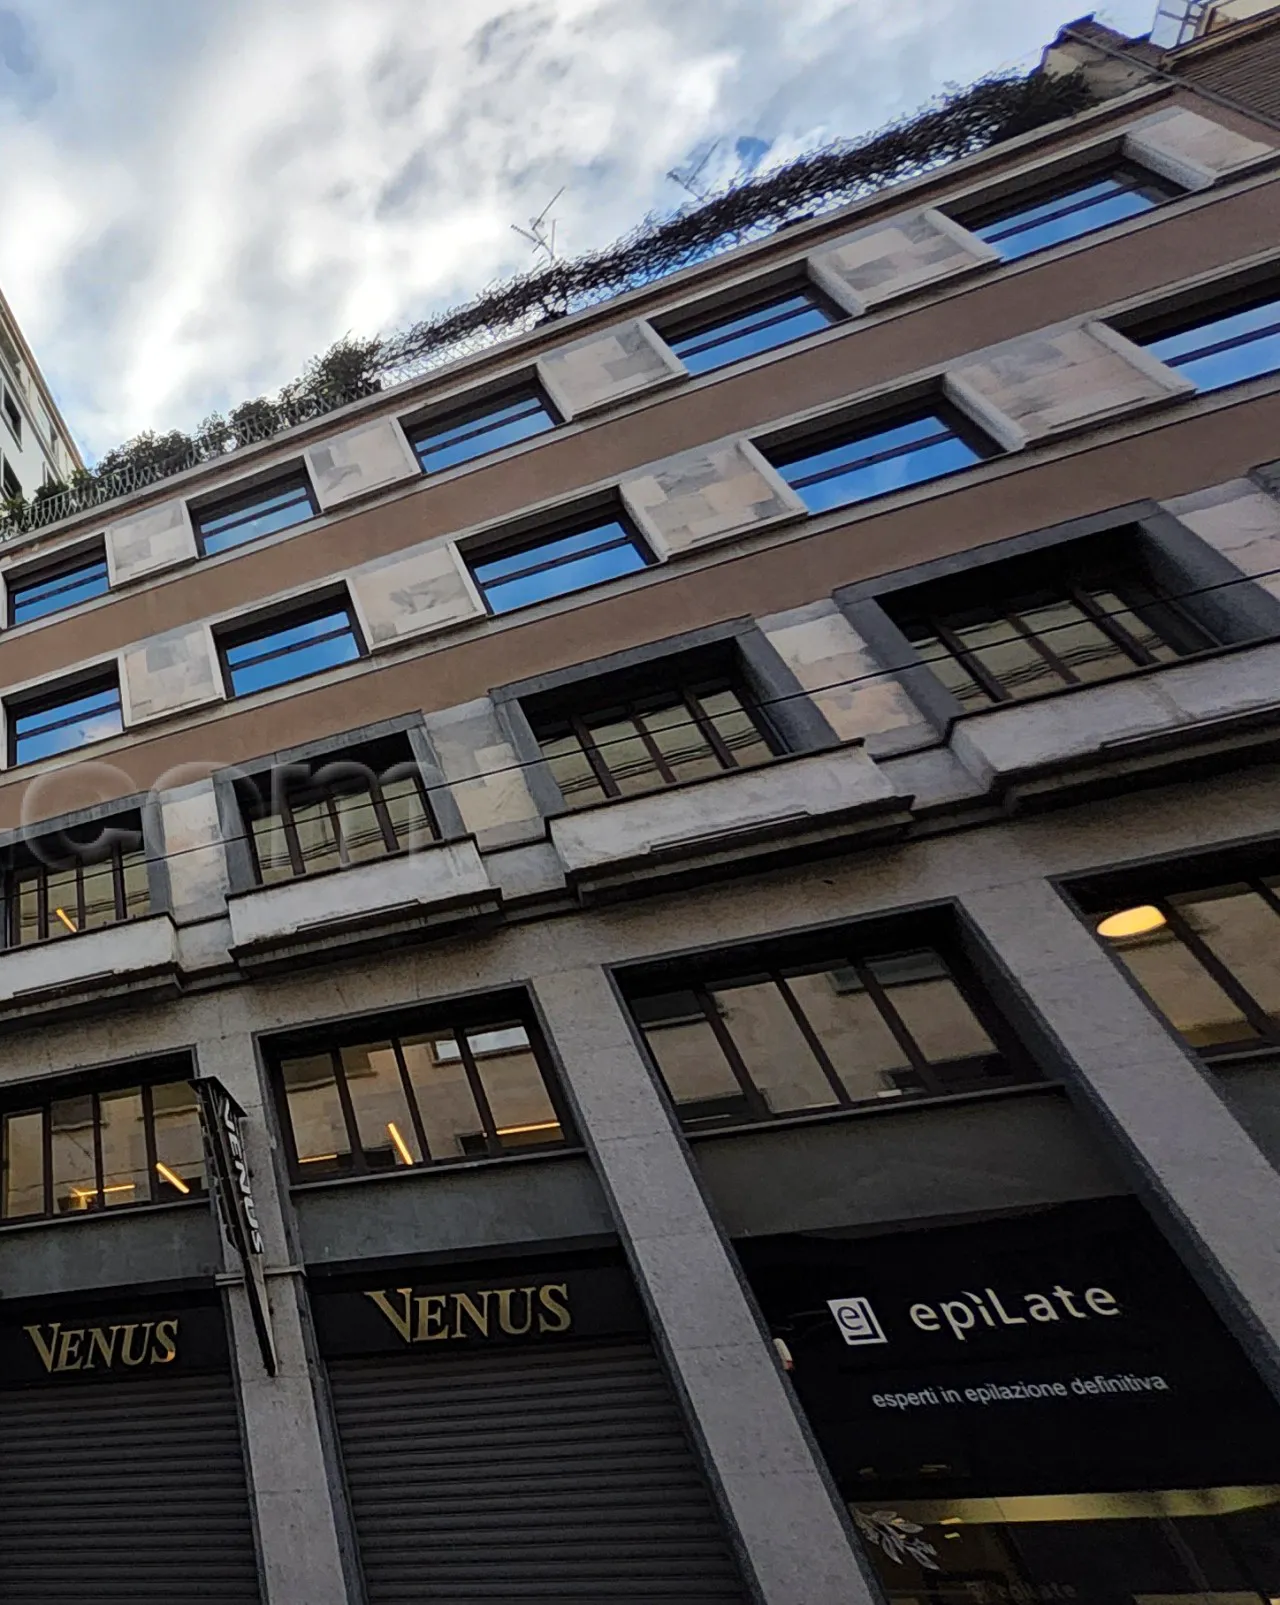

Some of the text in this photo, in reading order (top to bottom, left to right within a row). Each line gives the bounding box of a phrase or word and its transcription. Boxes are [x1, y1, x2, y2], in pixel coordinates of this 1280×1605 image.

[219, 1096, 264, 1254] VENUS
[364, 1284, 572, 1343] VENUS
[23, 1320, 179, 1373] VENUS
[872, 1374, 1169, 1410] esperti in epilazione definitiva
